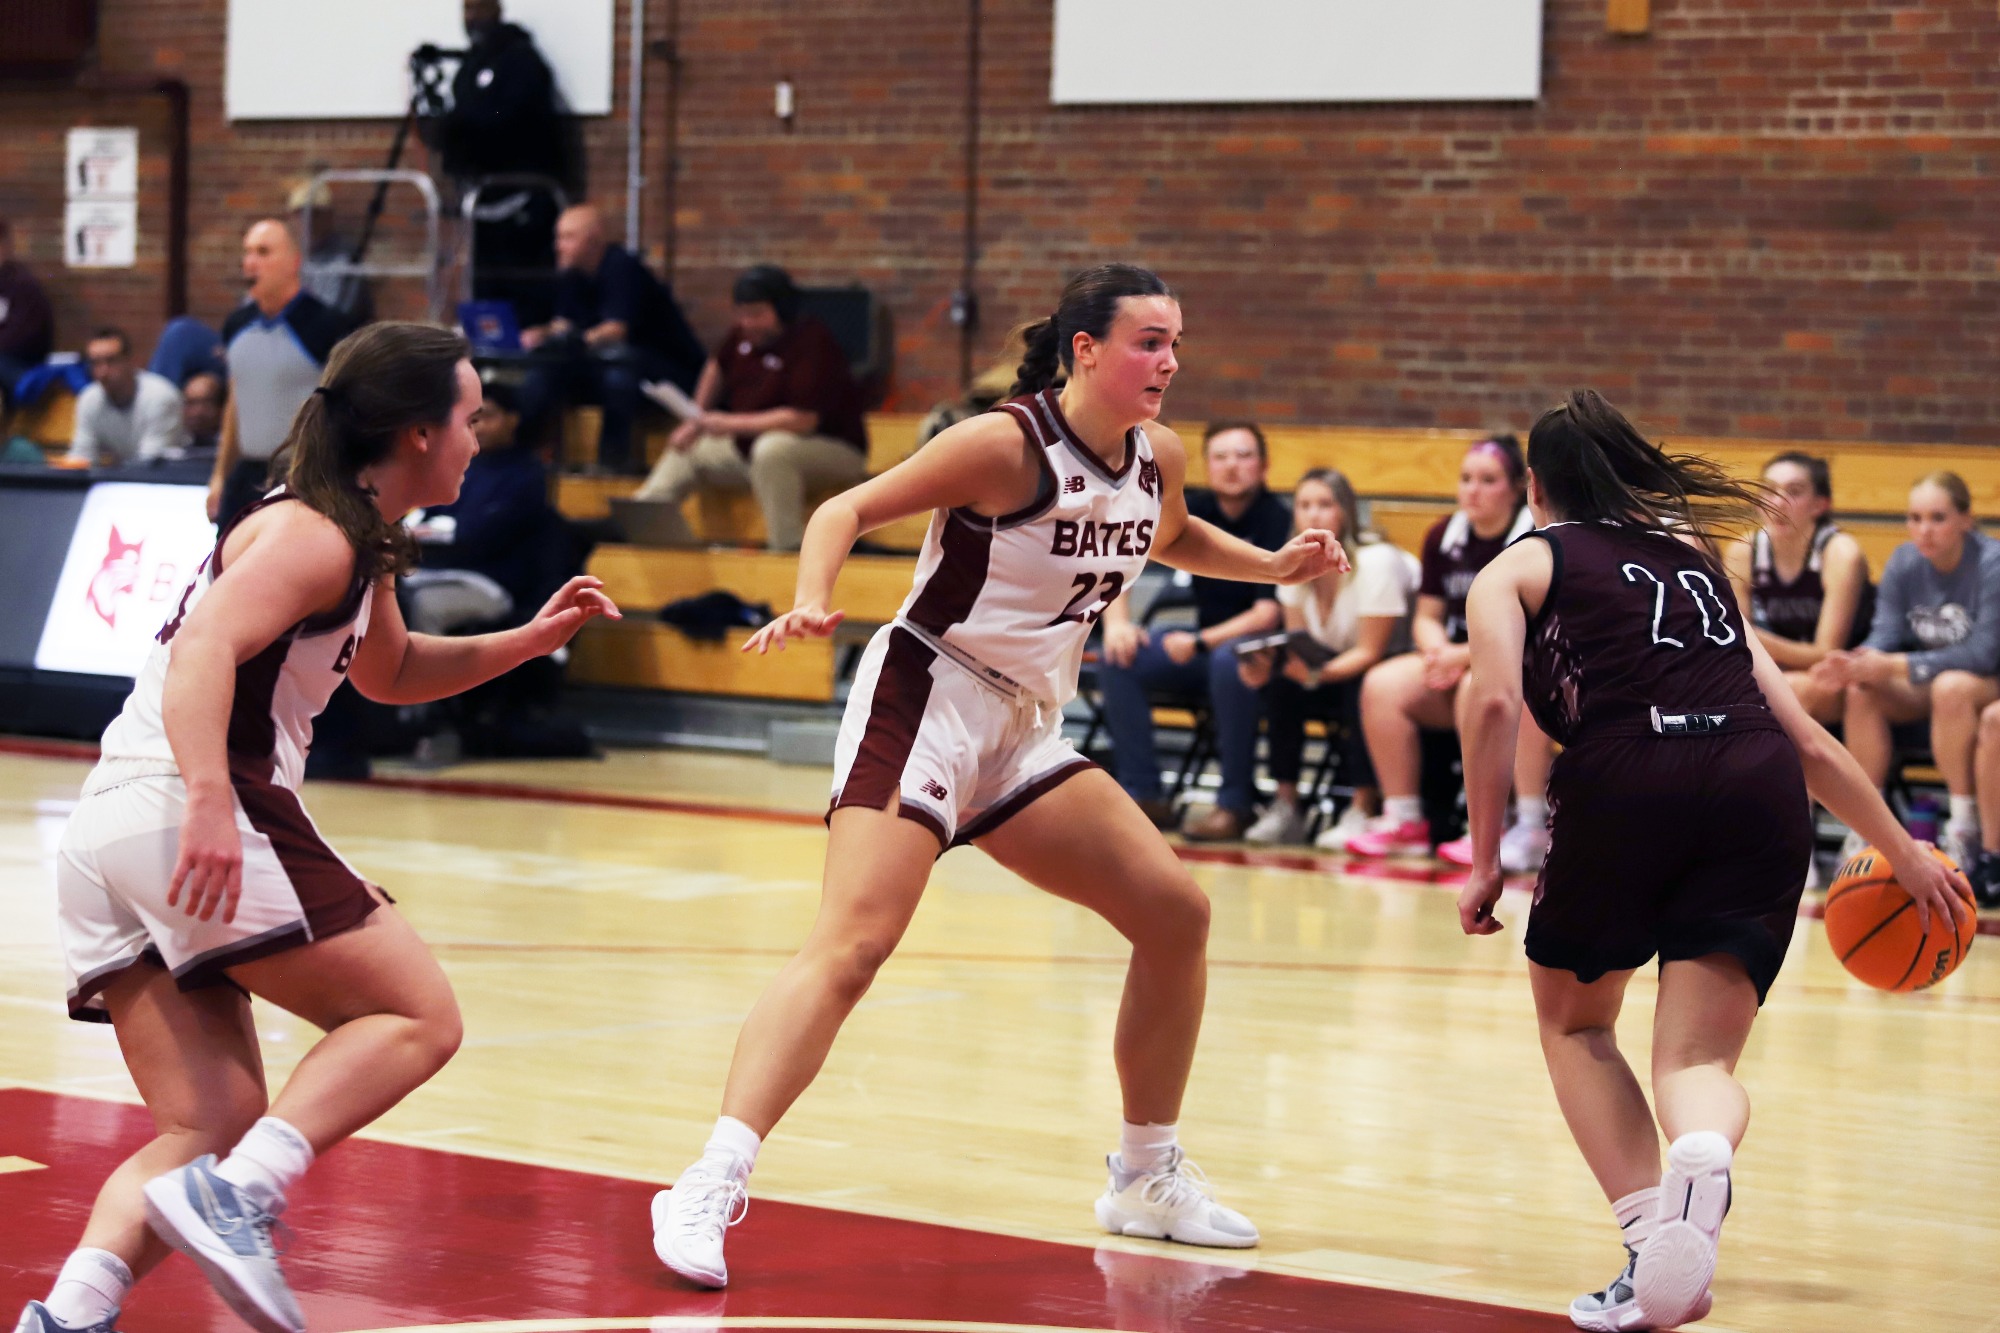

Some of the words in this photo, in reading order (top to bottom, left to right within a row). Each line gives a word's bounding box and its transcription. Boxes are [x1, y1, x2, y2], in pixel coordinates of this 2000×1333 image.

[1050, 519, 1154, 558] BATES
[1047, 571, 1125, 626] 23
[1622, 563, 1736, 648] 20
